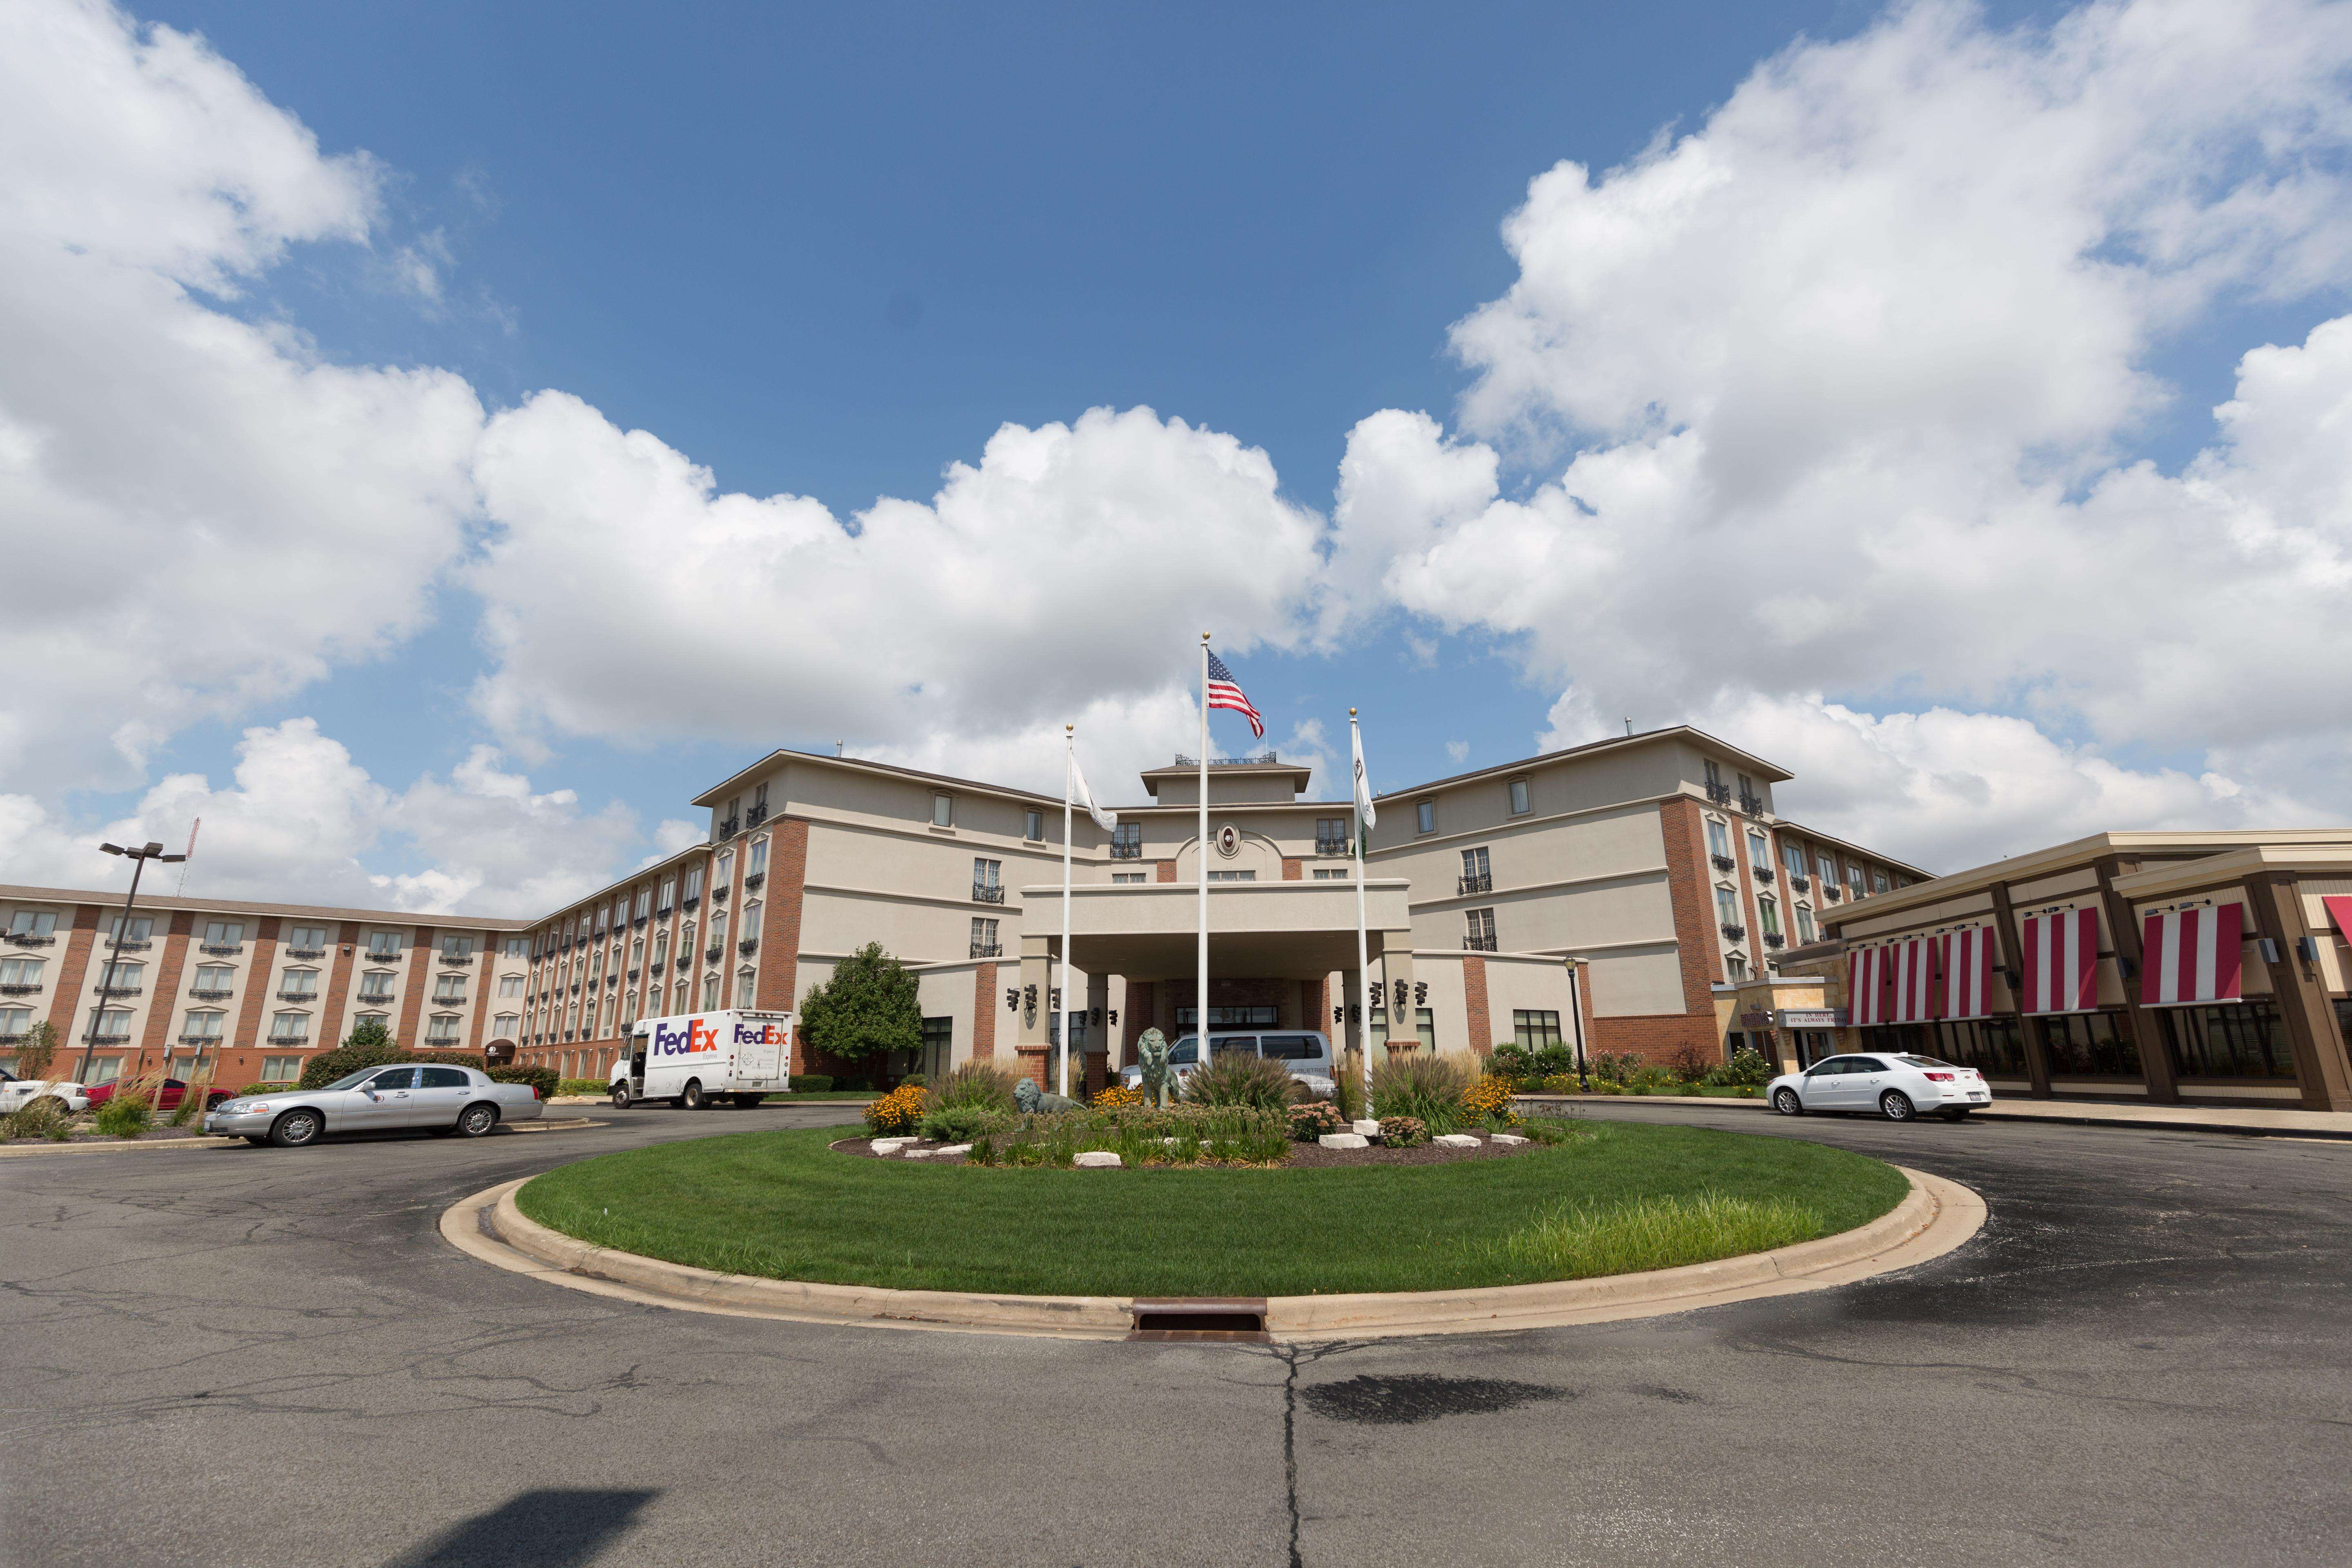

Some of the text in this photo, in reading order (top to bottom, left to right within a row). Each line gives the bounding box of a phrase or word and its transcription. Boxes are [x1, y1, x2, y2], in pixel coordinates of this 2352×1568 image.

[1740, 1011, 1771, 1027] FRIDAYS
[654, 1019, 719, 1056] FedEx
[734, 1024, 788, 1045] FedEx
